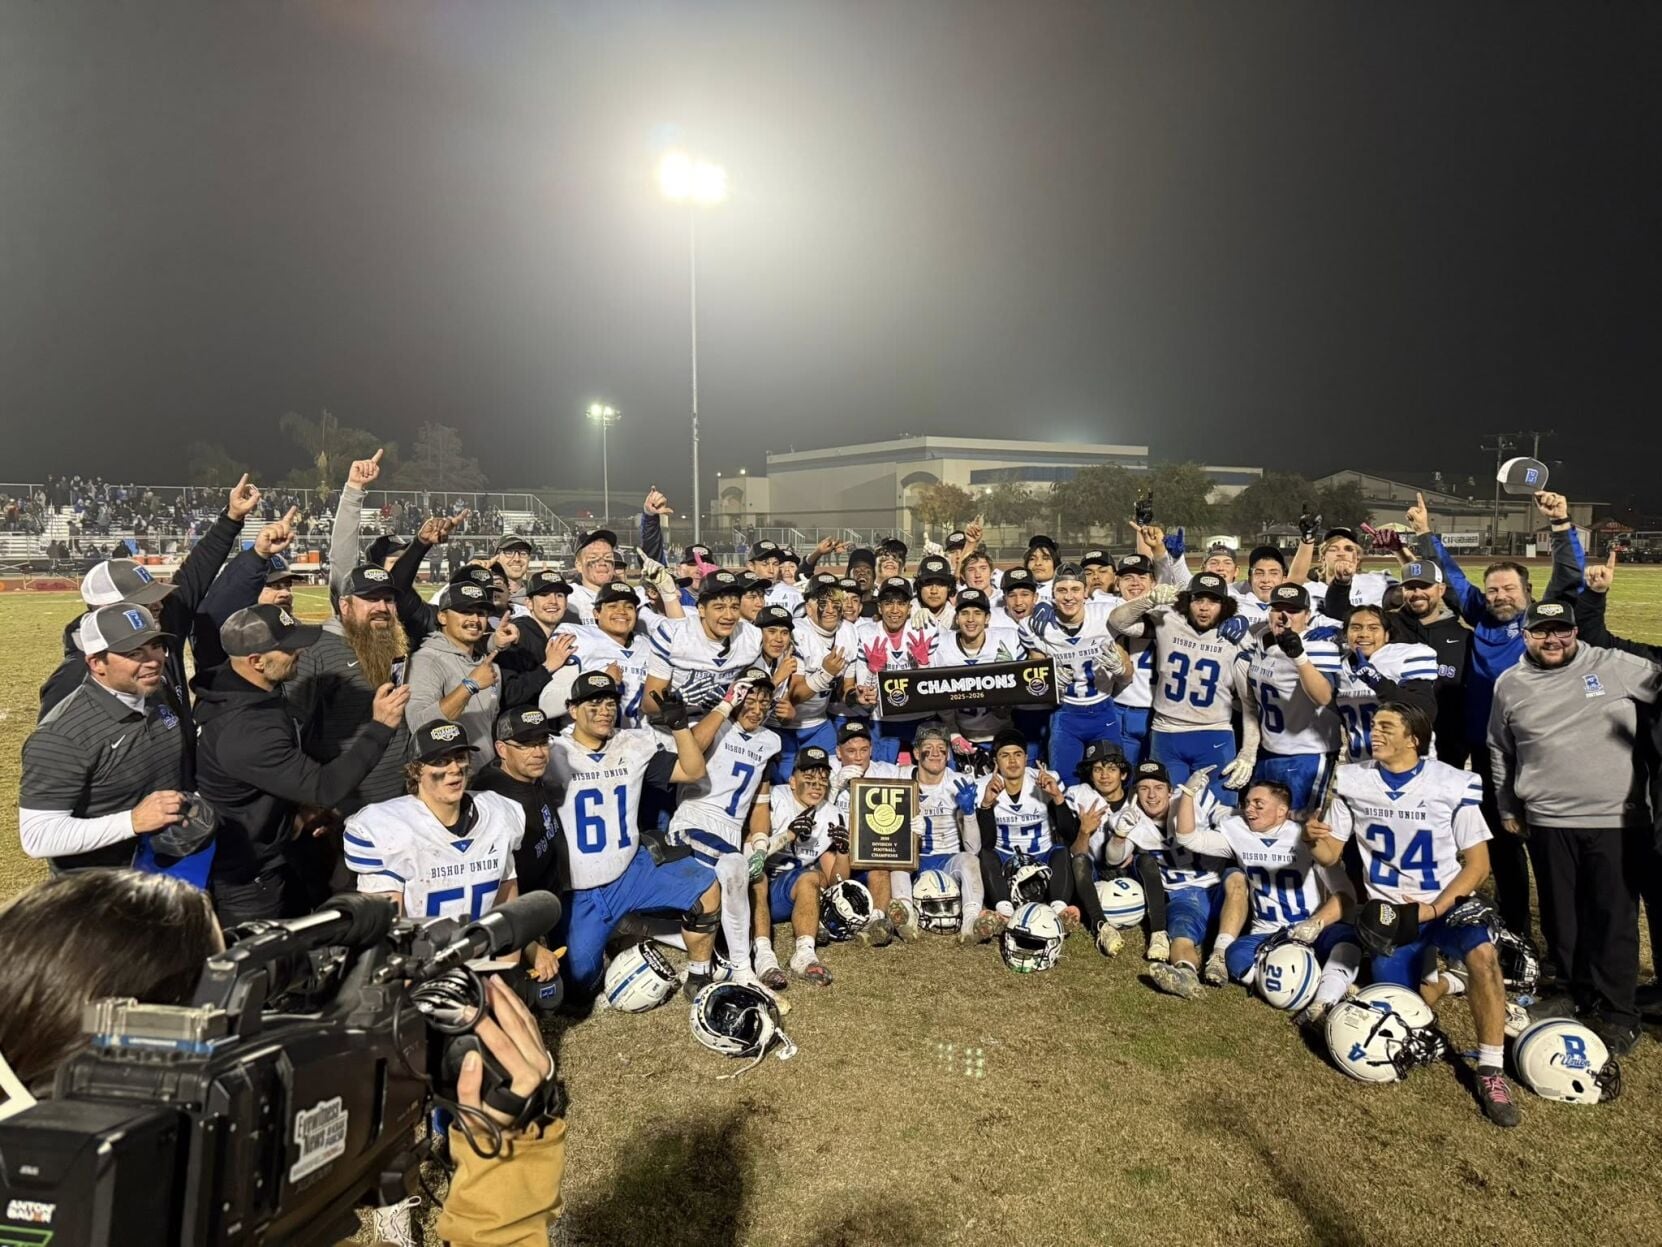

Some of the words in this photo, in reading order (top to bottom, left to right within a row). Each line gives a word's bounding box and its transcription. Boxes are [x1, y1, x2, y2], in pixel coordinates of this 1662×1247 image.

[1079, 647, 1099, 657] UNION
[1172, 636, 1197, 649] BISHOP
[1199, 643, 1223, 654] UNION
[916, 673, 1017, 695] CHAMPIONS
[1023, 667, 1049, 681] CIF
[1164, 650, 1221, 708] 33
[884, 679, 909, 694] CIF
[950, 692, 985, 700] 2025-2026
[724, 742, 746, 755] BISHOP
[747, 750, 763, 762] UNION
[572, 771, 601, 782] BISHOP
[604, 767, 629, 779] UNION
[725, 761, 755, 818] 7
[865, 787, 905, 811] CIF
[574, 784, 632, 855] 61
[924, 807, 944, 816] UNION
[1364, 807, 1394, 818] BISHOP
[1398, 810, 1426, 821] UNION
[997, 821, 1043, 854] 17
[1242, 851, 1268, 862] BISHOP
[1271, 853, 1297, 864] UNION
[1366, 823, 1441, 891] 24
[431, 864, 465, 879] BISHOP
[469, 858, 499, 873] UNION
[1247, 865, 1310, 923] 20
[1265, 964, 1283, 993] 20
[1347, 1042, 1367, 1062] 4
